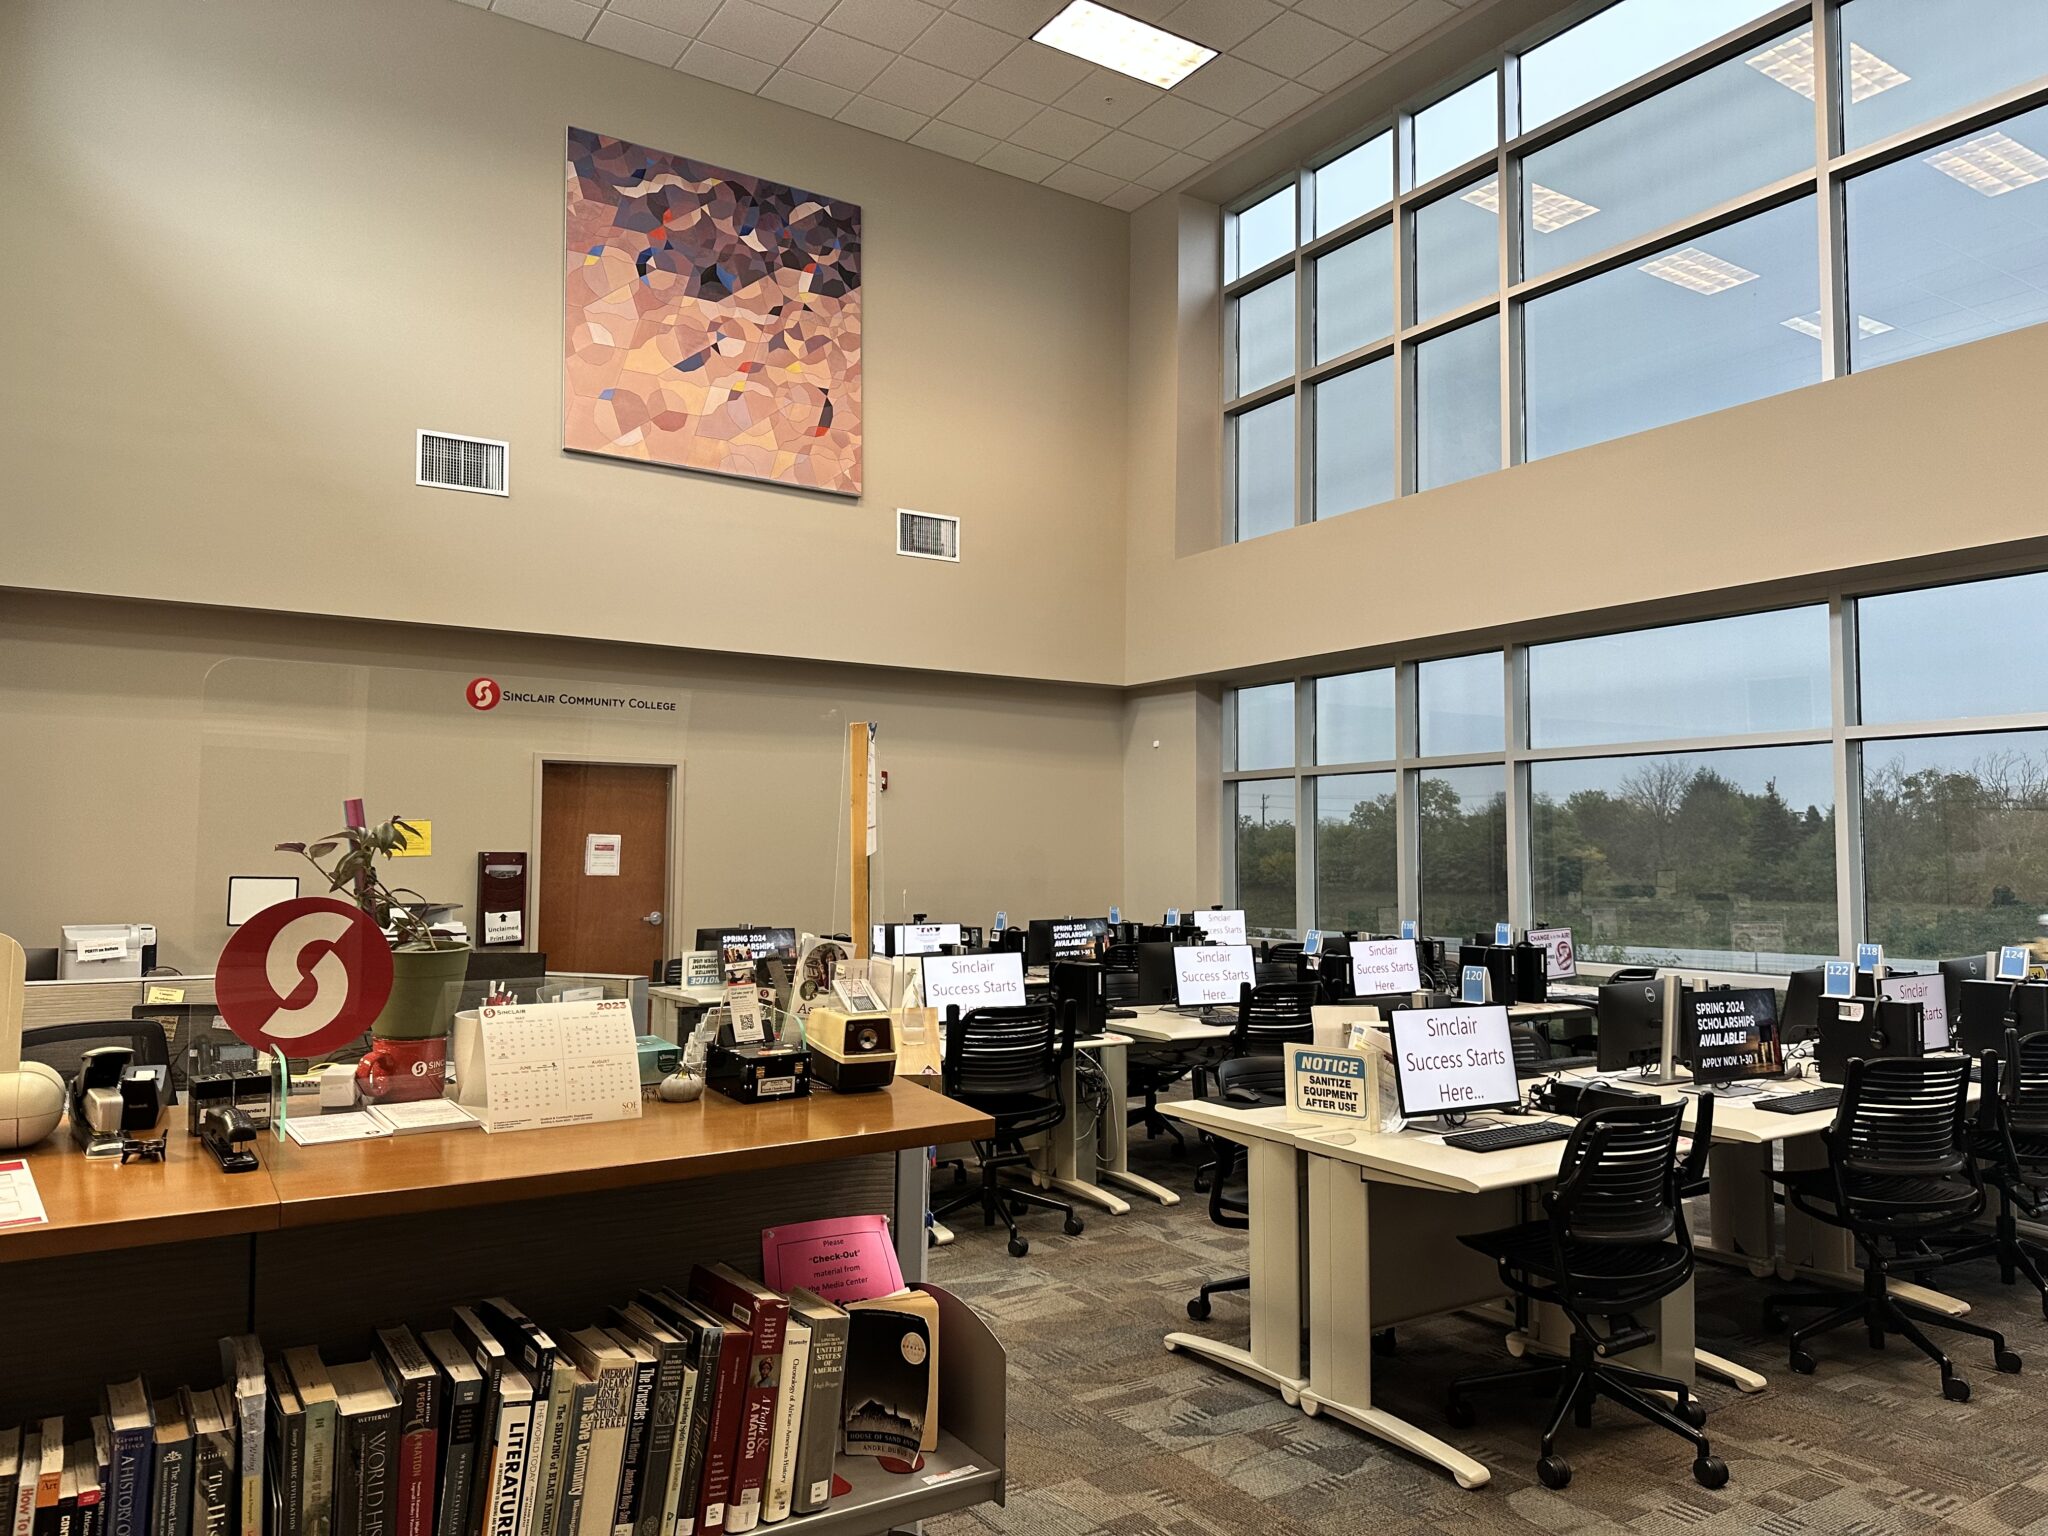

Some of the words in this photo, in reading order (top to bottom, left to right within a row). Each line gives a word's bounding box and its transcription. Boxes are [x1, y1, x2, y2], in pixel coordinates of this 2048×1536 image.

[503, 691, 555, 704] SINCLAIR
[559, 694, 625, 707] COMMUNITY
[629, 698, 676, 711] COLLEGE
[1208, 913, 1231, 922] Sinclair
[488, 924, 519, 933] Unclaimed
[1196, 951, 1231, 962] Sinclair
[1368, 944, 1398, 956] Sinclair
[1861, 947, 1878, 955] 118
[2005, 950, 2023, 959] 124
[951, 960, 995, 974] Sinclair
[1357, 964, 1390, 974] Success
[1390, 962, 1414, 972] Starts
[1465, 970, 1482, 980] 120
[1828, 966, 1848, 976] 122
[1182, 971, 1220, 982] Success
[1222, 970, 1249, 980] Starts
[932, 983, 980, 997] Success
[984, 980, 1017, 992] Starts
[1900, 983, 1928, 999] Sinclair
[596, 1002, 627, 1010] 2023
[1696, 1002, 1725, 1015] SPRING
[1726, 1000, 1745, 1014] 2024
[1427, 1016, 1477, 1037] Sinclair
[1698, 1015, 1755, 1031] SCHOLARSHIPS
[1699, 1031, 1746, 1047] AVAILABLE!
[1301, 1056, 1358, 1075] NOTICE
[1406, 1052, 1463, 1071] Success
[1466, 1048, 1505, 1066] Starts
[1702, 1057, 1722, 1069] APPLY
[1723, 1056, 1739, 1066] NOV.
[1740, 1054, 1753, 1065] 1-30
[1309, 1075, 1351, 1088] SANITIZE
[1303, 1086, 1358, 1101] EQUIPMENT
[1439, 1084, 1484, 1102] Here...
[1306, 1098, 1335, 1110] AFTER
[1338, 1102, 1357, 1112] USE
[823, 1239, 844, 1247] Please
[814, 1267, 843, 1278] material
[822, 1281, 844, 1291] Media
[846, 1277, 868, 1286] Center
[600, 1368, 633, 1378] AMERICAN
[638, 1367, 655, 1383] The
[789, 1358, 799, 1394] Chronology
[813, 1366, 842, 1375] AMERICA
[598, 1378, 629, 1388] DREAMS
[597, 1388, 615, 1398] LOST
[582, 1394, 597, 1411] The
[595, 1398, 619, 1409] FOUND
[633, 1385, 652, 1421] Crusades
[751, 1403, 760, 1411] A
[357, 1412, 390, 1423] WETTERAU
[537, 1403, 545, 1421] THE
[556, 1404, 567, 1420] The
[594, 1408, 618, 1418] STUDS
[578, 1412, 595, 1440] Slave
[593, 1417, 625, 1429] TERKEL
[756, 1406, 770, 1435] People
[532, 1422, 543, 1453] WORLD
[745, 1414, 760, 1459] NATION
[783, 1404, 795, 1459] African-American
[551, 1422, 564, 1460] SHAPING
[756, 1438, 770, 1454] &
[121, 1456, 135, 1466] A
[290, 1449, 298, 1478] ISLAMIC
[367, 1430, 386, 1506] WORLD
[528, 1455, 539, 1483] TODAY
[549, 1462, 559, 1470] of
[568, 1442, 591, 1496] Community
[171, 1464, 180, 1480] The
[780, 1459, 790, 1483] History
[208, 1470, 223, 1503] The
[545, 1472, 556, 1500] BLACK
[118, 1466, 134, 1523] HISTORY
[169, 1482, 179, 1516] Attentive
[289, 1480, 298, 1530] CIVILISATION
[116, 1524, 131, 1536] O
